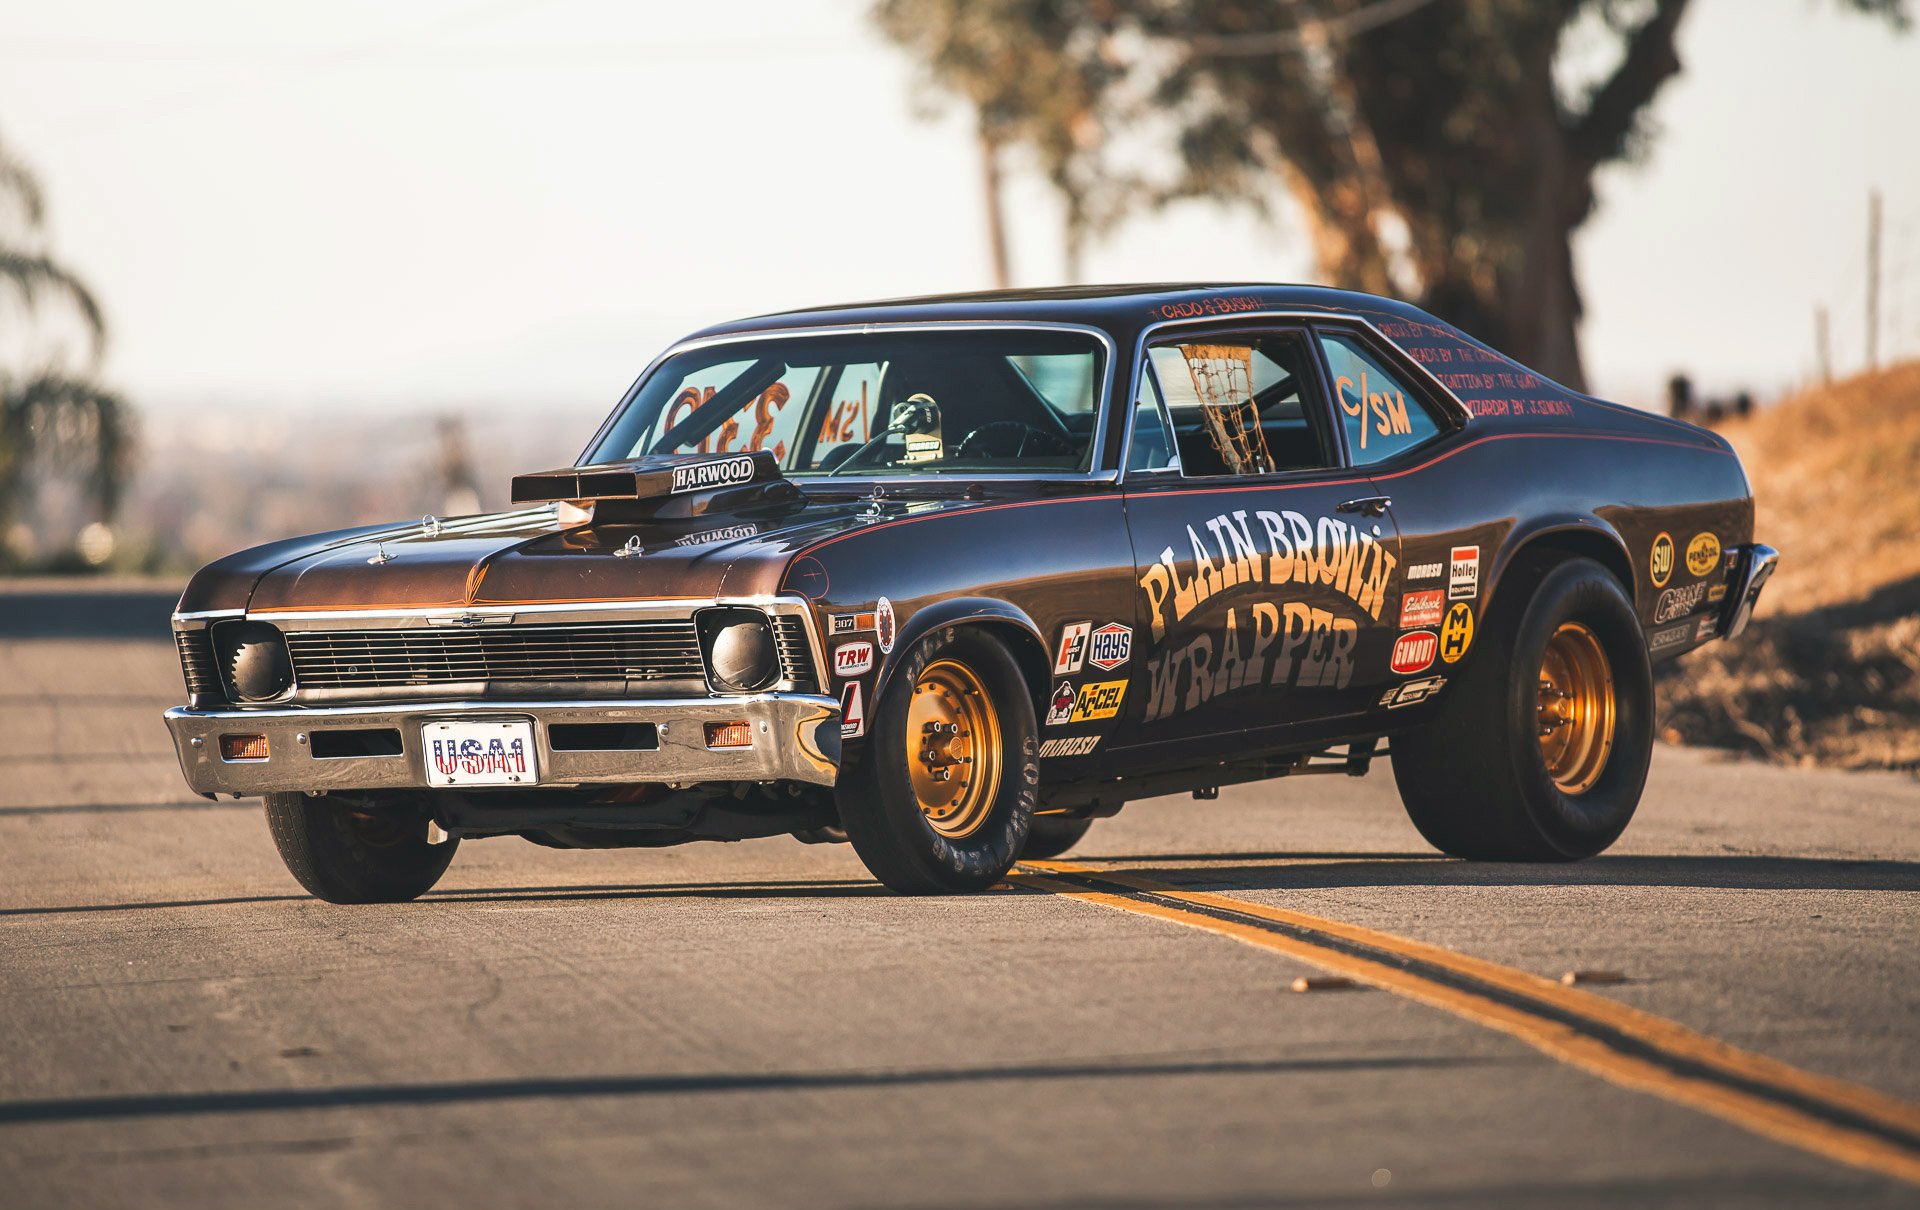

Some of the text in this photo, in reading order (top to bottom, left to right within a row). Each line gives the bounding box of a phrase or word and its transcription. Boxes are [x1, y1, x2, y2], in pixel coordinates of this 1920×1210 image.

[1161, 302, 1204, 319] CADO
[1203, 299, 1216, 315] &
[1335, 372, 1412, 449] C/SM
[676, 460, 752, 487] HARWOOD
[1452, 563, 1477, 579] Holley
[1653, 545, 1671, 573] SW
[1140, 509, 1397, 645] PLAIN BROWN
[1404, 595, 1441, 612] Edelbrock
[835, 618, 853, 628] 307
[837, 647, 871, 667] TRW
[1093, 632, 1130, 660] Hays
[1395, 638, 1435, 665] GUMOUT
[1143, 602, 1358, 723] WRAPPER
[1039, 735, 1102, 758] MOROSO
